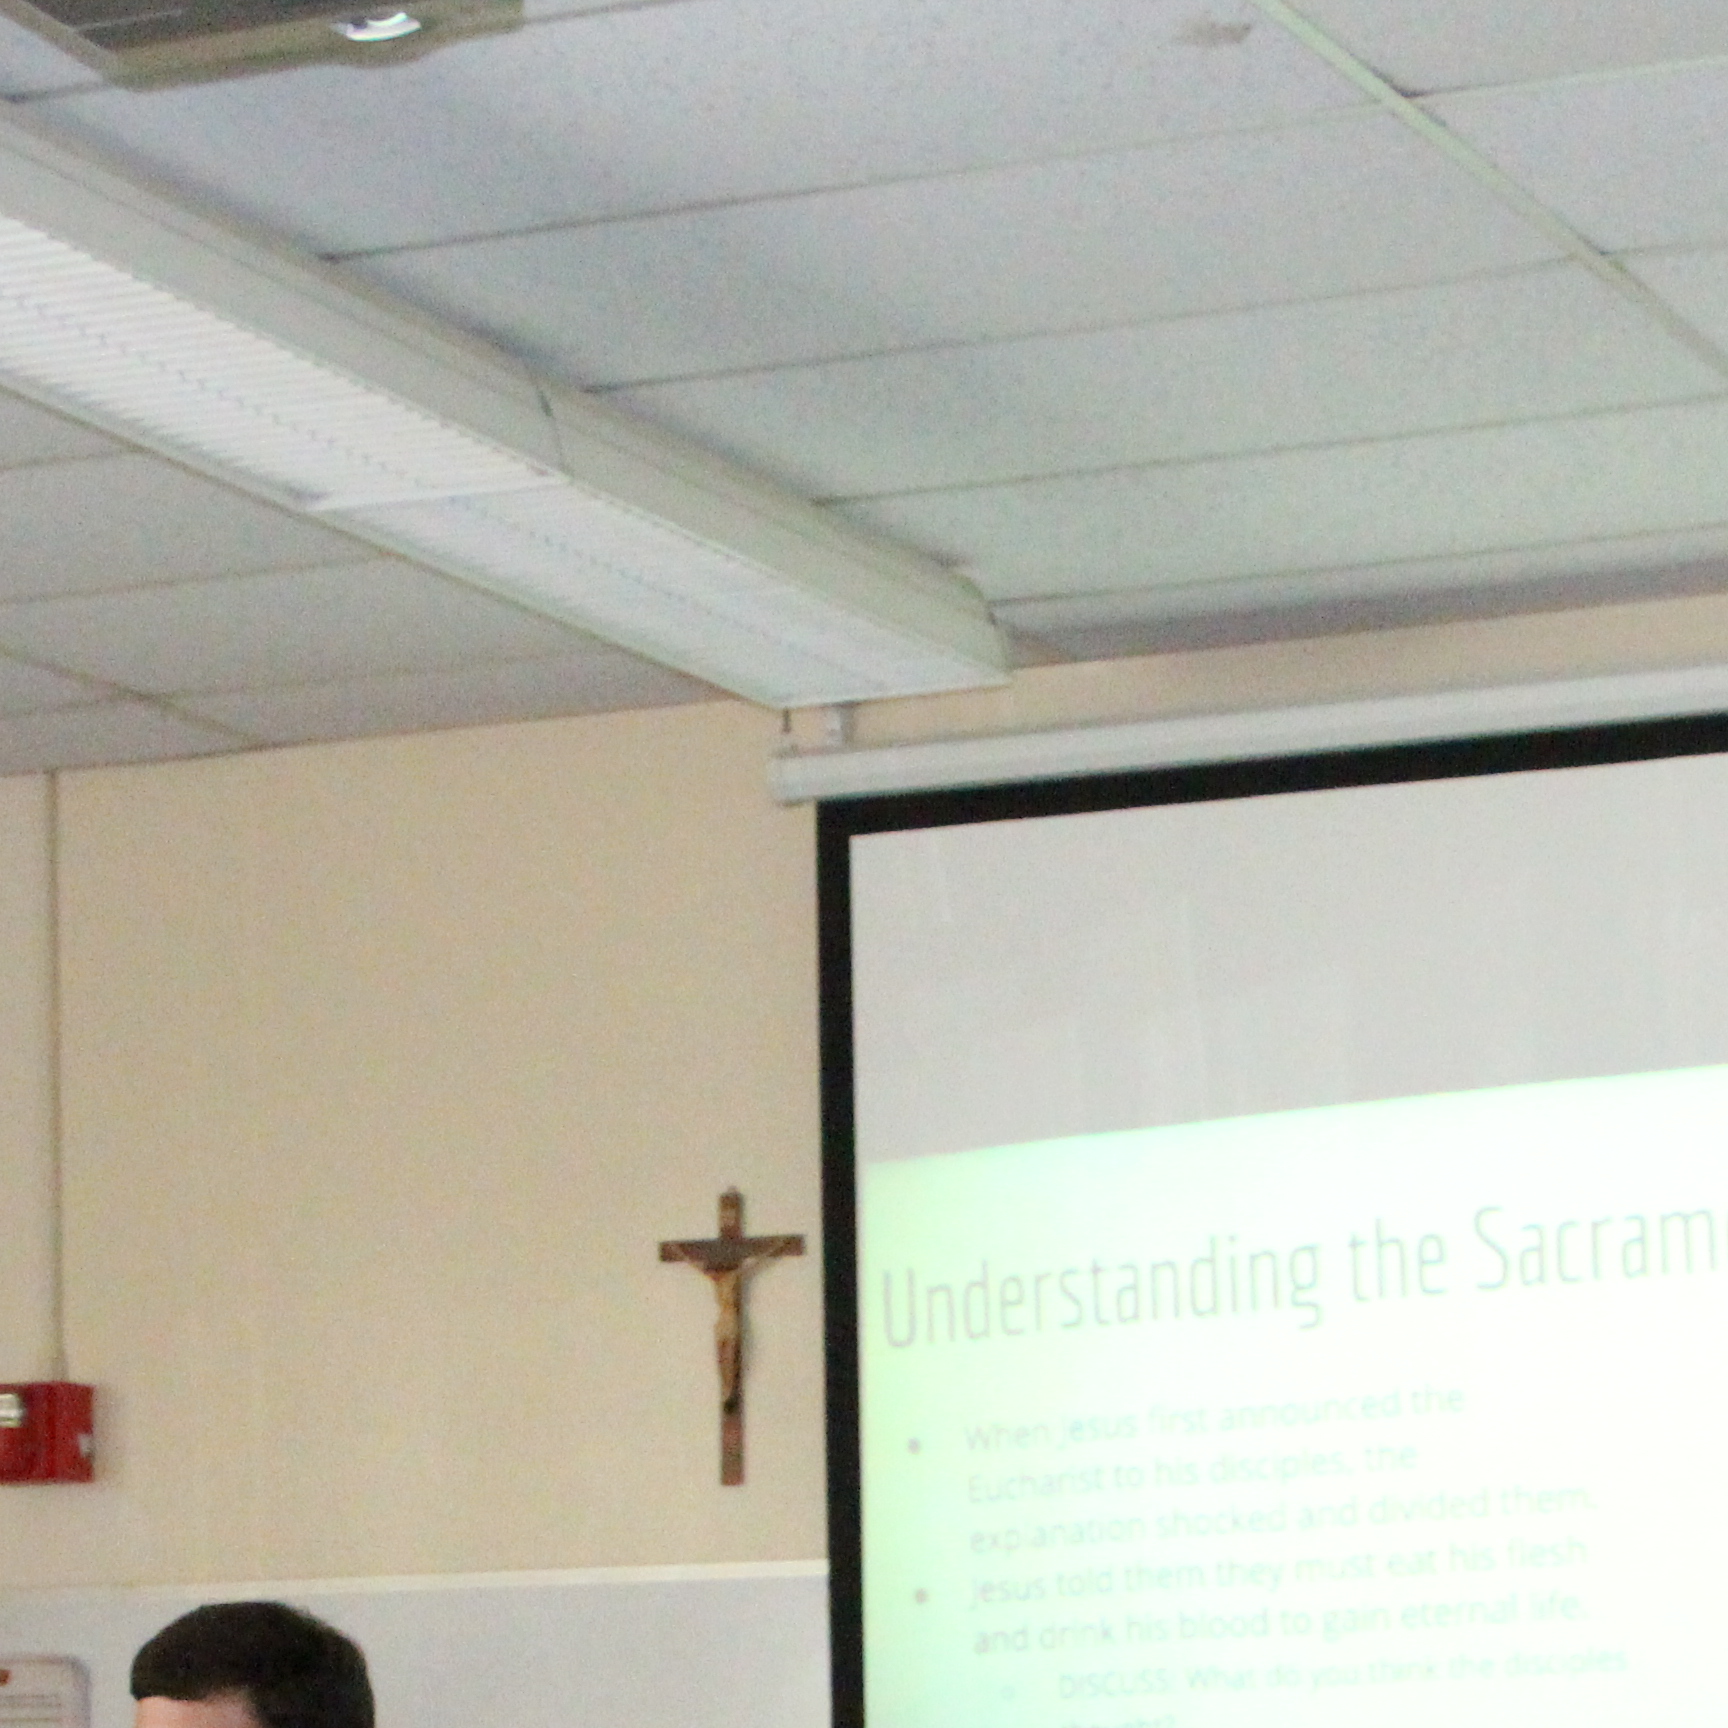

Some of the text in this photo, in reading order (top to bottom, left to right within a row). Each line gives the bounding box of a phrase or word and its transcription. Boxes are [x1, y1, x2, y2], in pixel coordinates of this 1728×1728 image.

[881, 1234, 1325, 1350] Understanding
[1346, 1217, 1448, 1304] the
[964, 1420, 1052, 1454] When
[1147, 1404, 1210, 1438] first
[1217, 1391, 1402, 1434] announced
[1410, 1384, 1467, 1418] the
[1112, 1461, 1146, 1490] to
[1152, 1458, 1201, 1489] his
[1363, 1441, 1421, 1474] the
[1156, 1502, 1287, 1540] shocked
[1296, 1496, 1360, 1531] and
[1367, 1486, 1491, 1525] divided
[1054, 1561, 1113, 1596] told
[1123, 1555, 1207, 1591] them
[1214, 1551, 1284, 1592] they
[1293, 1549, 1377, 1582] must
[1384, 1544, 1440, 1578] eat
[1447, 1538, 1497, 1572] his
[972, 1618, 1030, 1658] and
[1037, 1608, 1116, 1651] drink
[1124, 1604, 1170, 1640] his
[1177, 1599, 1272, 1639] blood
[1278, 1605, 1314, 1636] to
[1321, 1602, 1392, 1642] gain
[1400, 1590, 1518, 1629] eternal
